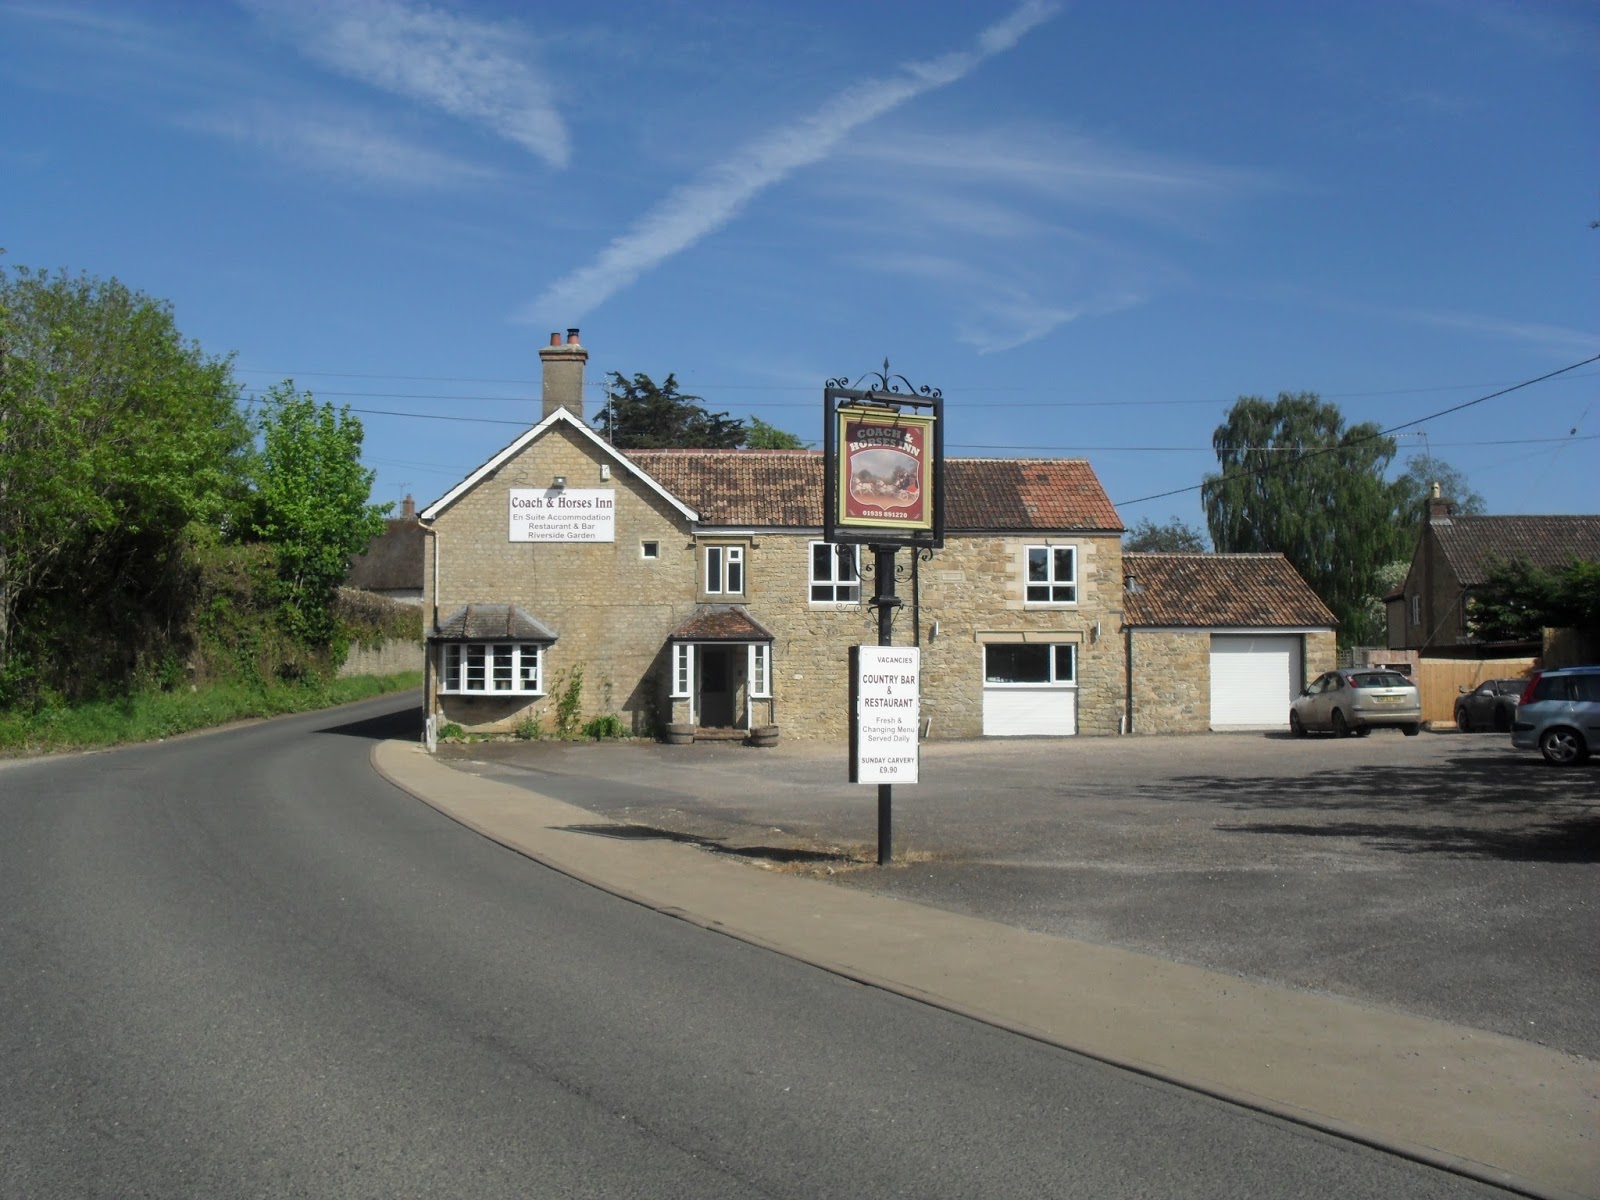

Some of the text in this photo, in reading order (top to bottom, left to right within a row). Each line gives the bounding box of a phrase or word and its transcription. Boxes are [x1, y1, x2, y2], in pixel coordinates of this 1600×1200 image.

[857, 428, 914, 443] COACH &
[850, 437, 921, 457] HORSES INN
[512, 497, 612, 508] Coach & Horses Inn
[863, 674, 915, 684] COUNTRY BAR
[887, 686, 892, 694] &
[864, 698, 913, 708] RESTAURANT
[862, 726, 896, 734] Changing
[893, 735, 910, 743] Daily
